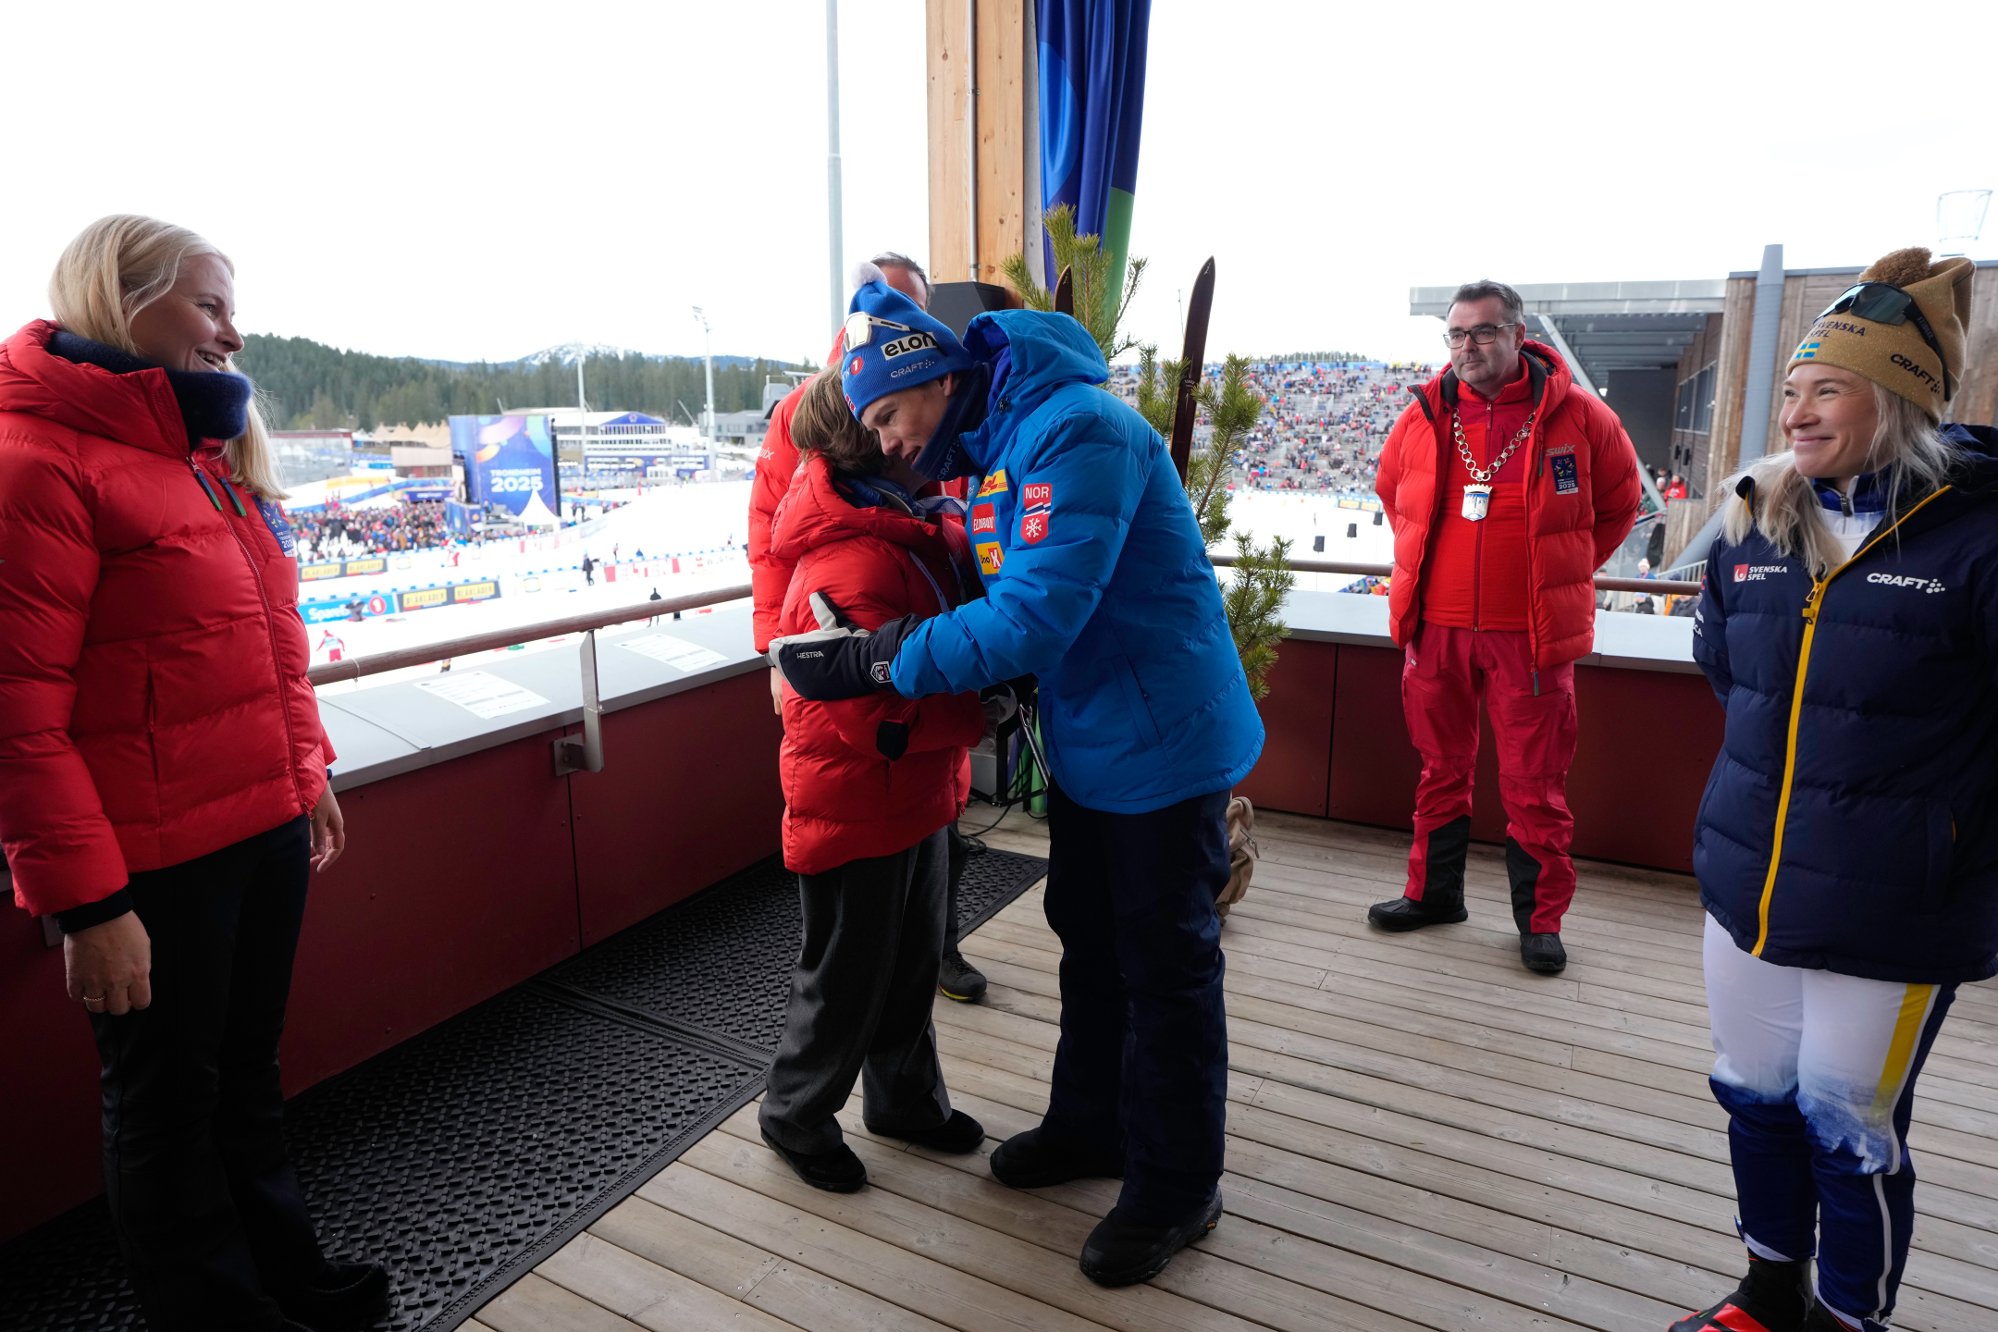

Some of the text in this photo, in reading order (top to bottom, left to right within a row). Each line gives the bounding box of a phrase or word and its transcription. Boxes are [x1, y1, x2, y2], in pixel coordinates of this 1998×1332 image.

[890, 362, 924, 378] CRAFT
[1890, 353, 1935, 385] CRAFT
[937, 446, 957, 480] CRAFT
[491, 476, 544, 492] 2025
[1025, 486, 1049, 499] NOR
[1747, 573, 1766, 581] SPEL
[1749, 565, 1788, 574] SVENSKA
[1866, 572, 1929, 590] CRAFT
[796, 651, 824, 659] HESTRA
